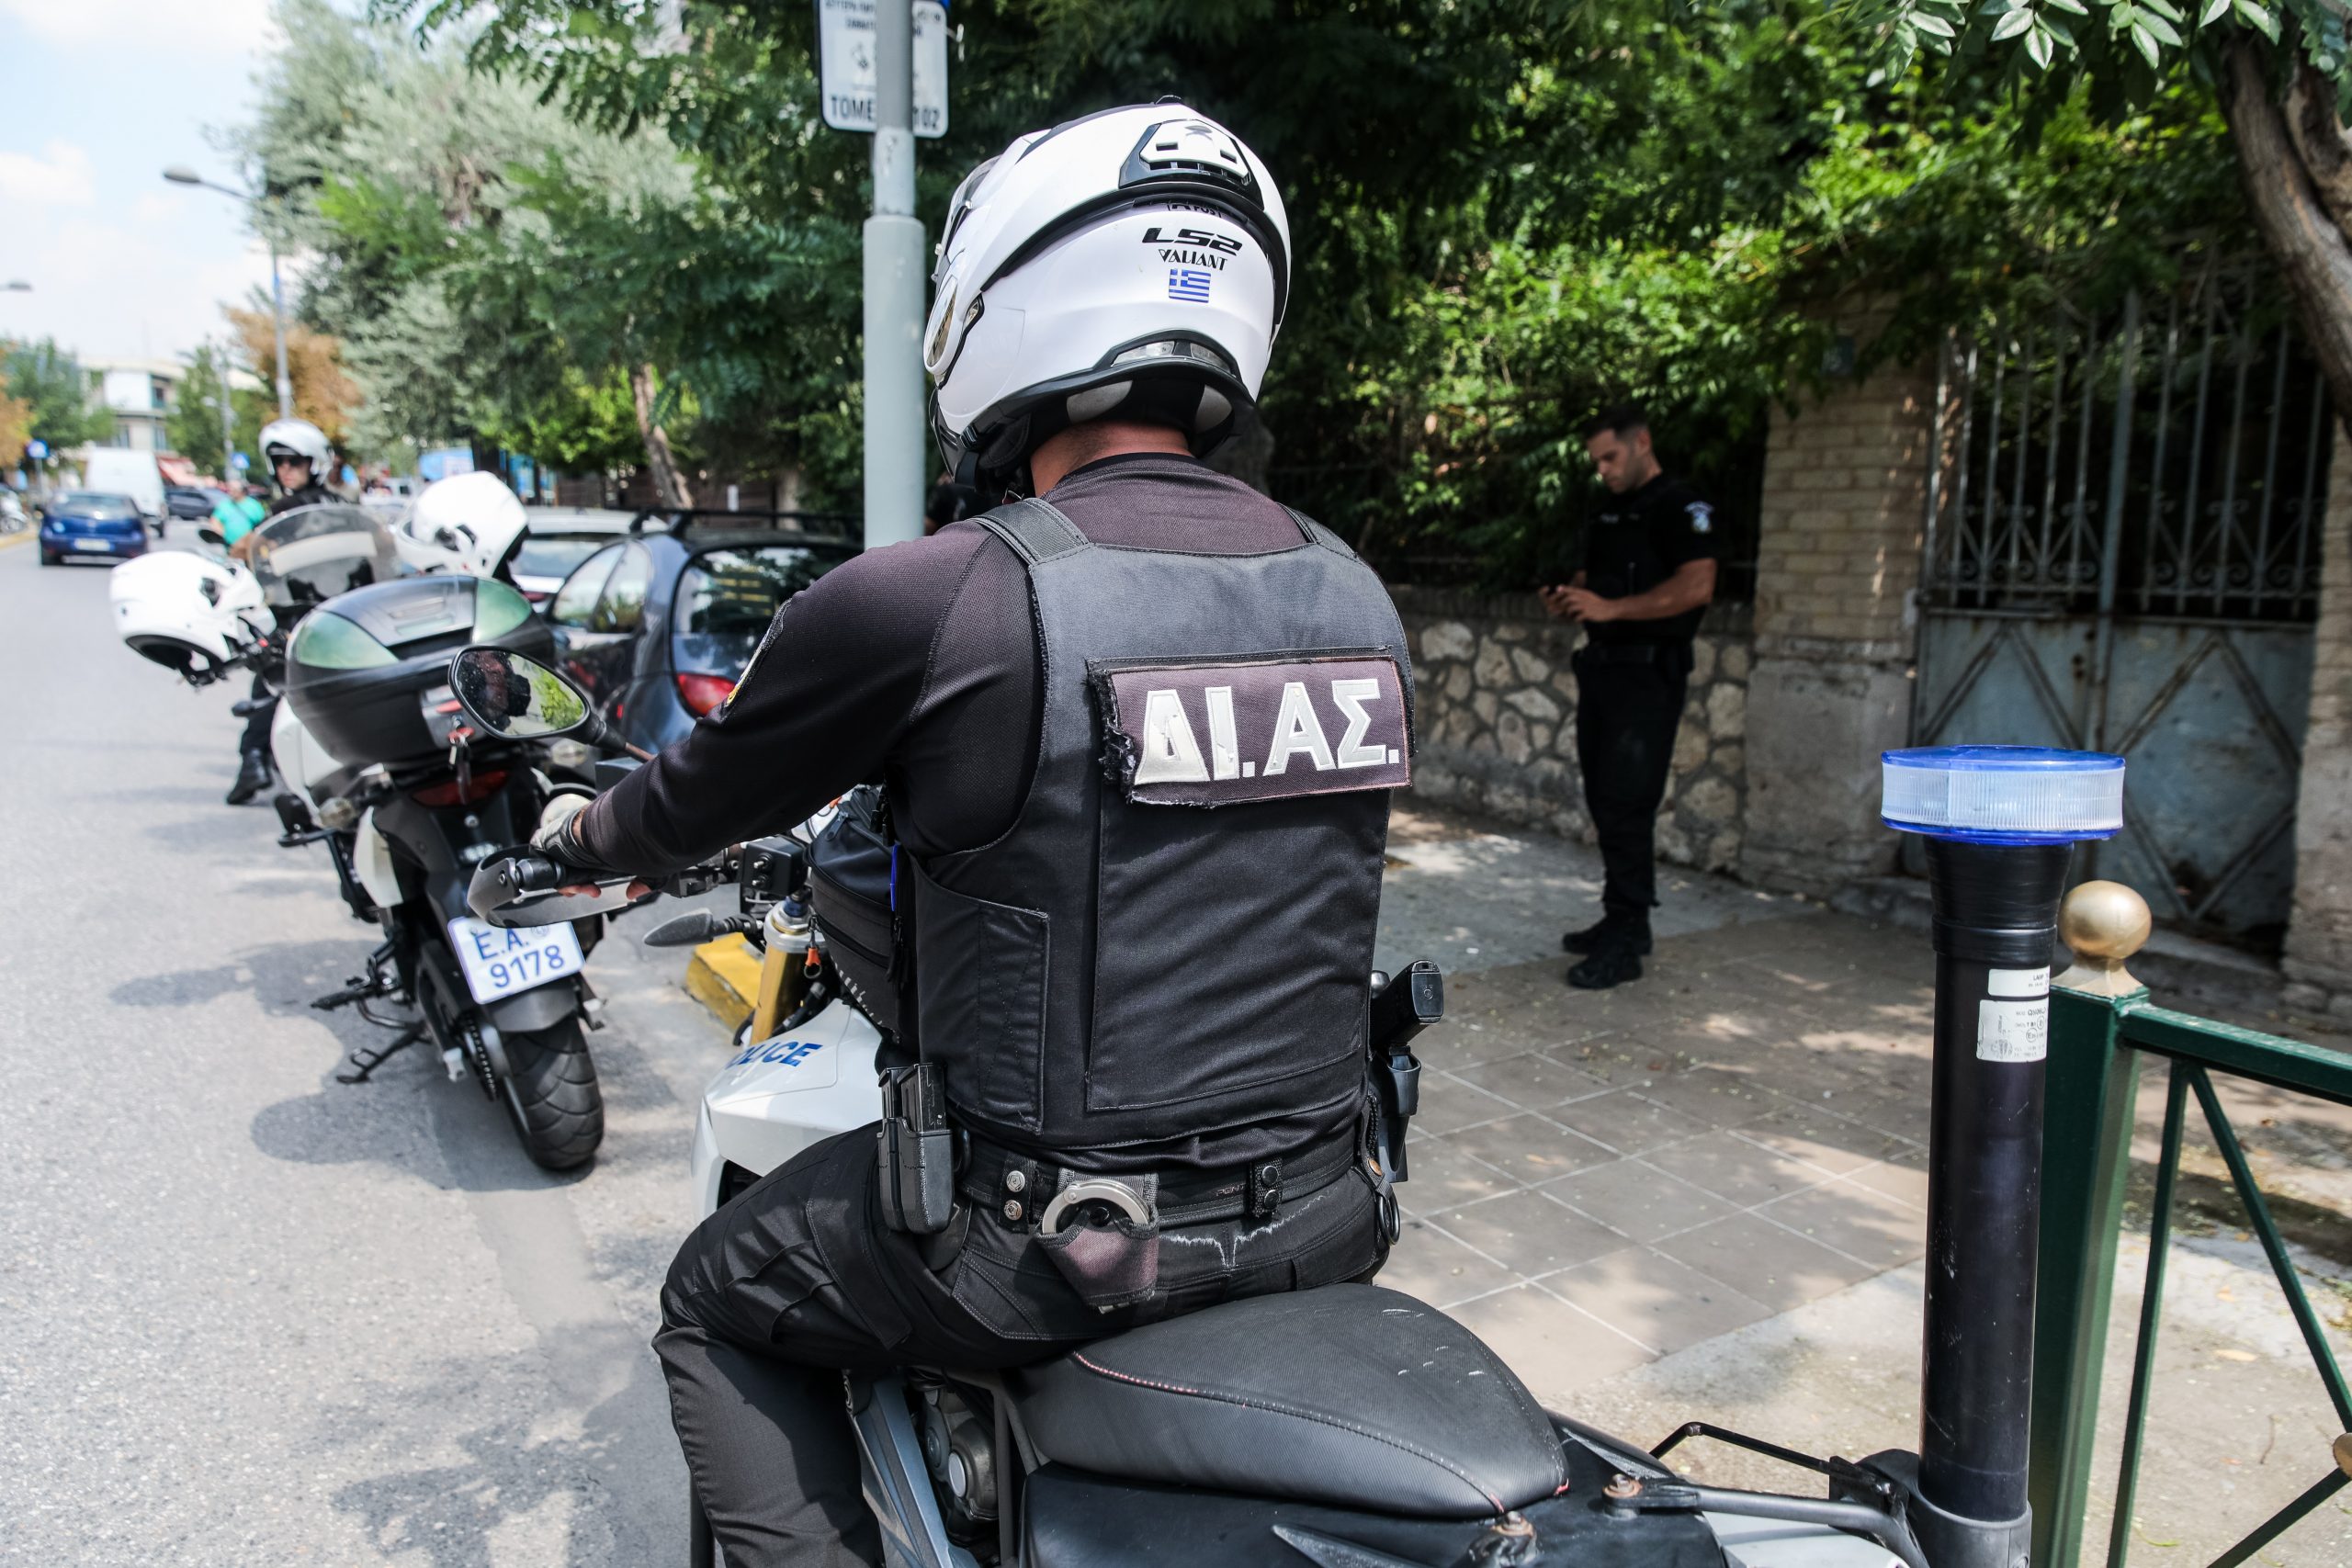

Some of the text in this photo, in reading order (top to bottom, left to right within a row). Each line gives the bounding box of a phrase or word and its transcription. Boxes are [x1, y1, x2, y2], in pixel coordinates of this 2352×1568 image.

[1142, 228, 1242, 256] LS2
[1158, 249, 1227, 271] VALIANT
[490, 944, 565, 988] 9178
